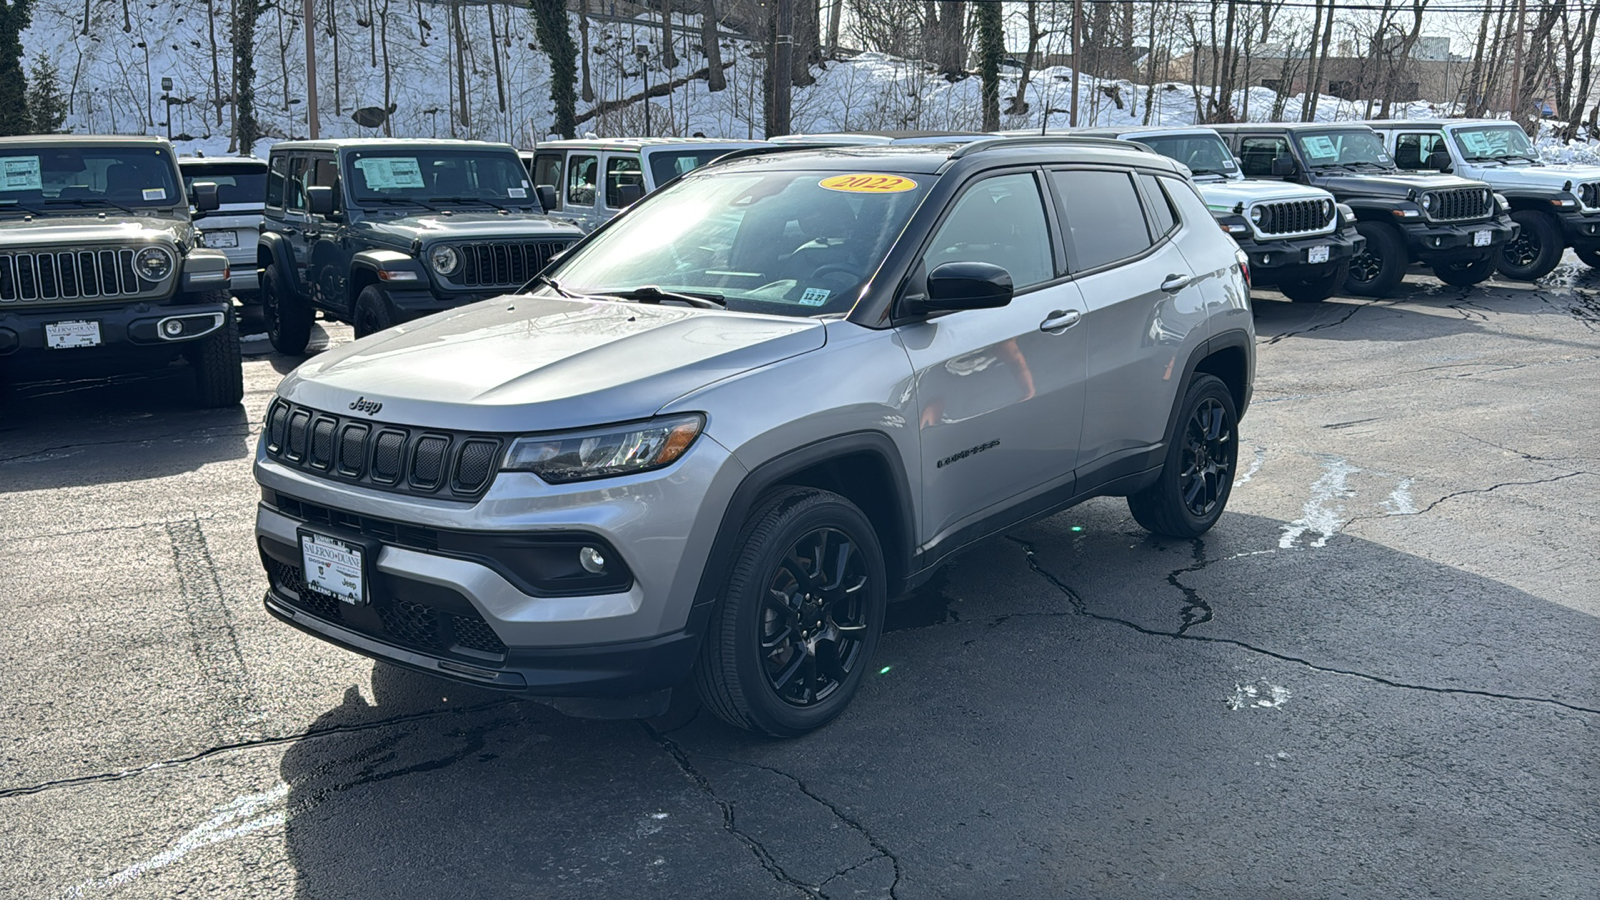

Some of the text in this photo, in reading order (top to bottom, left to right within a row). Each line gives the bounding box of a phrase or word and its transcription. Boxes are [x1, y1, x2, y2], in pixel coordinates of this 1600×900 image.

[831, 177, 903, 189] 2022
[803, 292, 815, 300] 12
[349, 396, 383, 416] Jeep
[304, 543, 361, 568] SALERNO DUANE
[341, 578, 357, 590] Jeep
[308, 584, 355, 606] SALERNO DUANE
